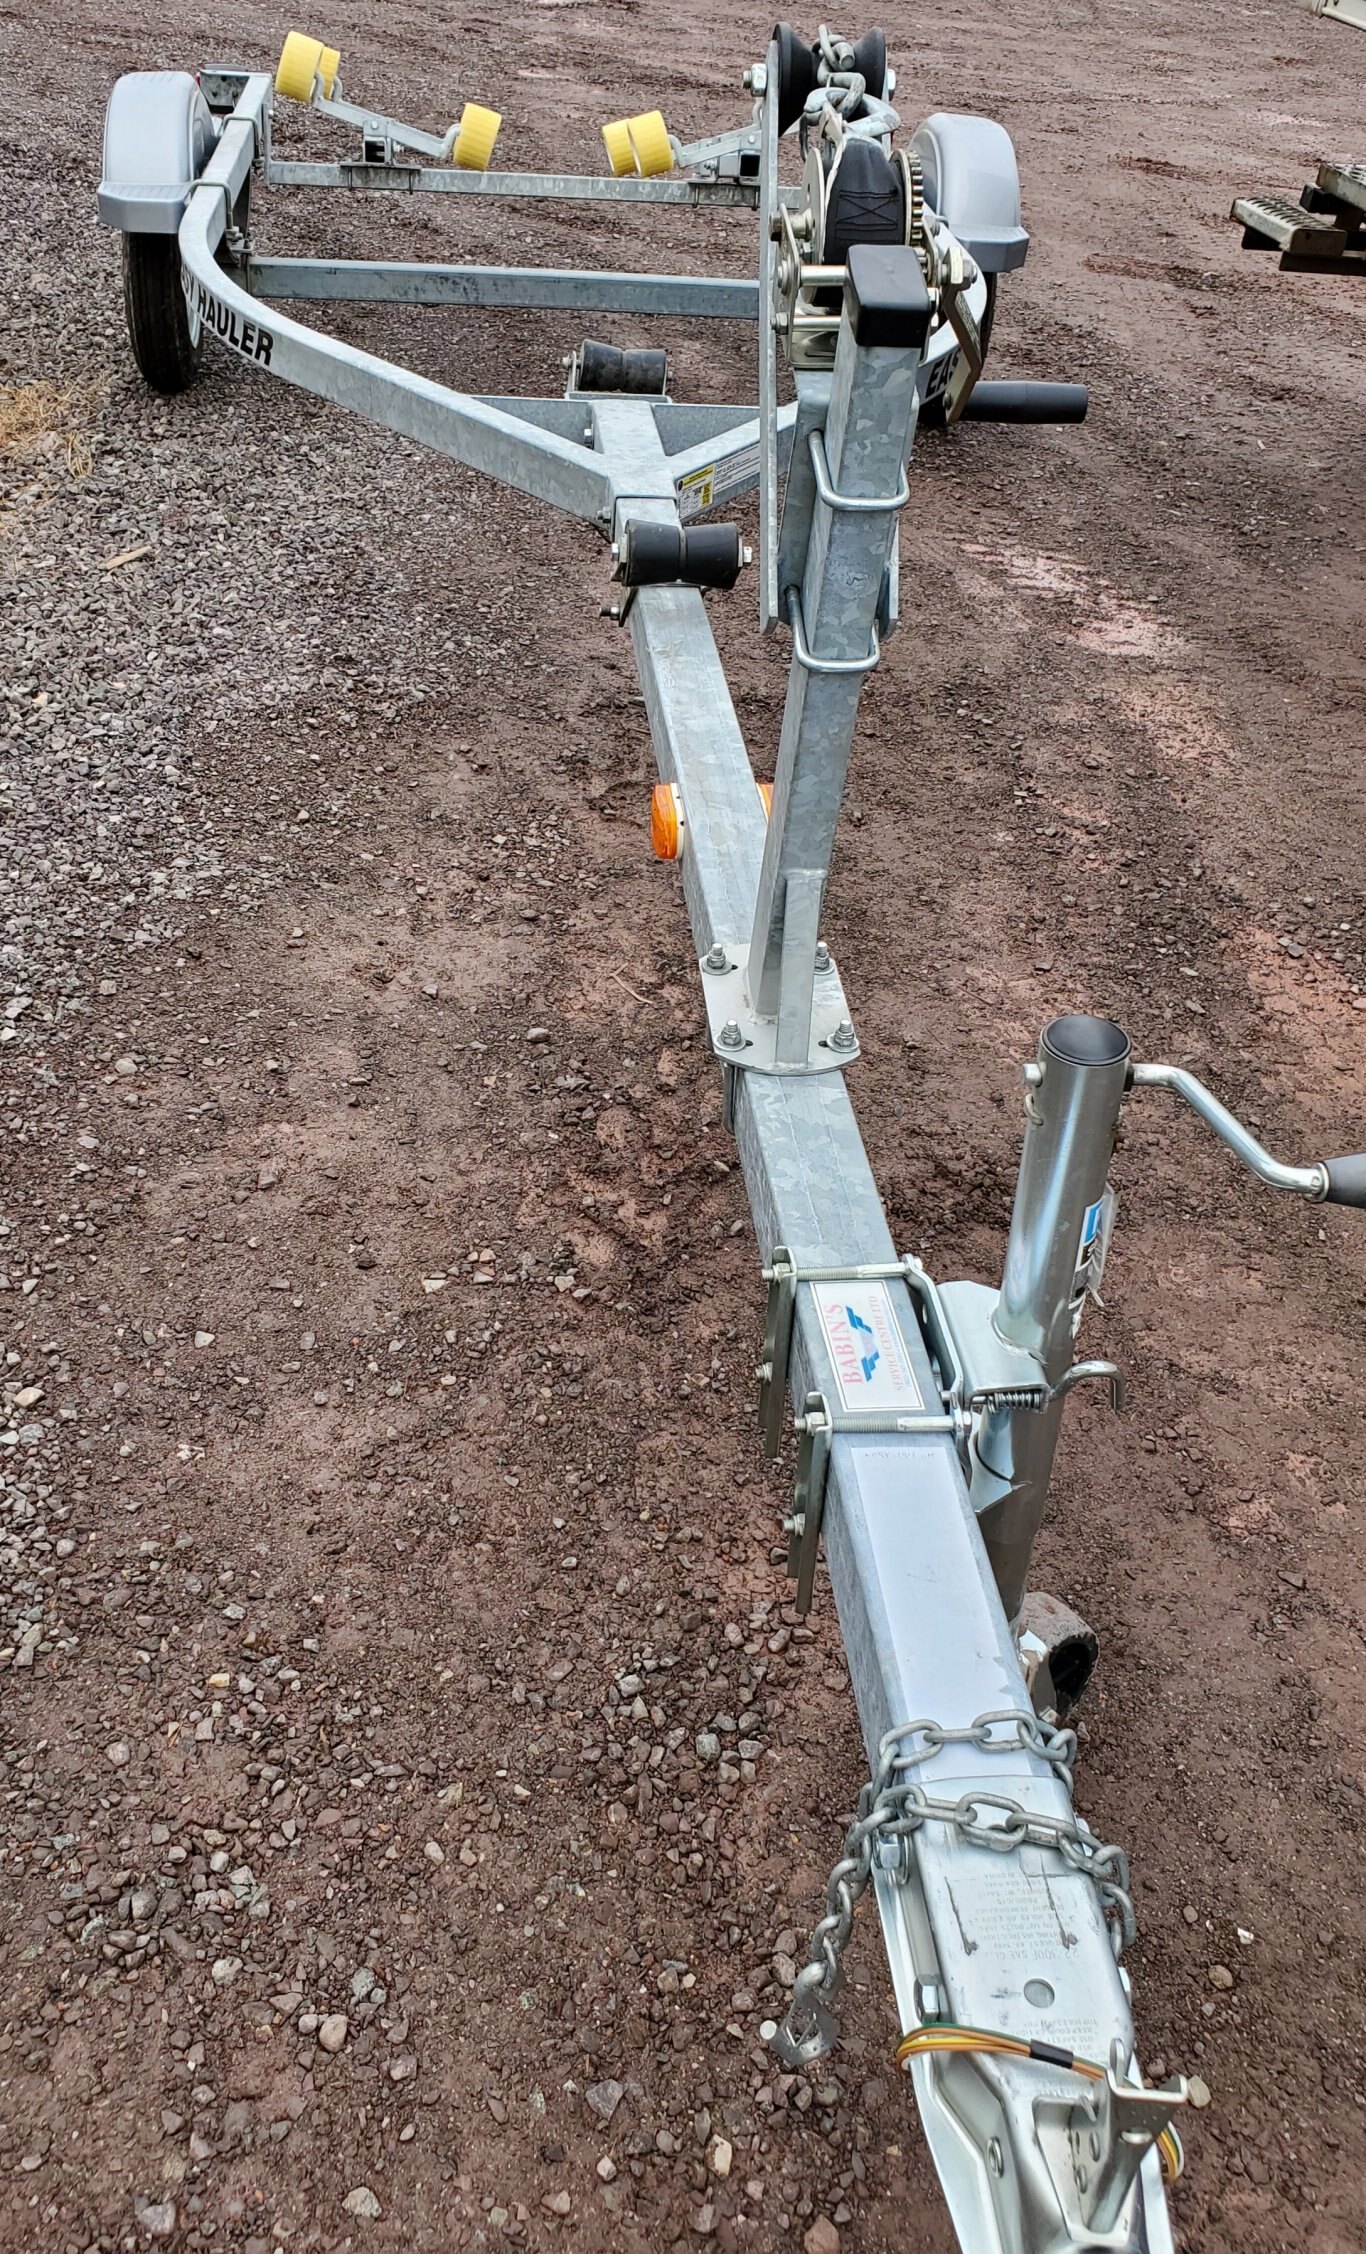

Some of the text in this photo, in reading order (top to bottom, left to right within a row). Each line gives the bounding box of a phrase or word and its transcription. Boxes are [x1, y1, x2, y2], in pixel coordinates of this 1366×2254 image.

[198, 283, 274, 366] HAULER
[824, 1304, 863, 1383] BABIN'S
[883, 1351, 905, 1391] SERVICE
